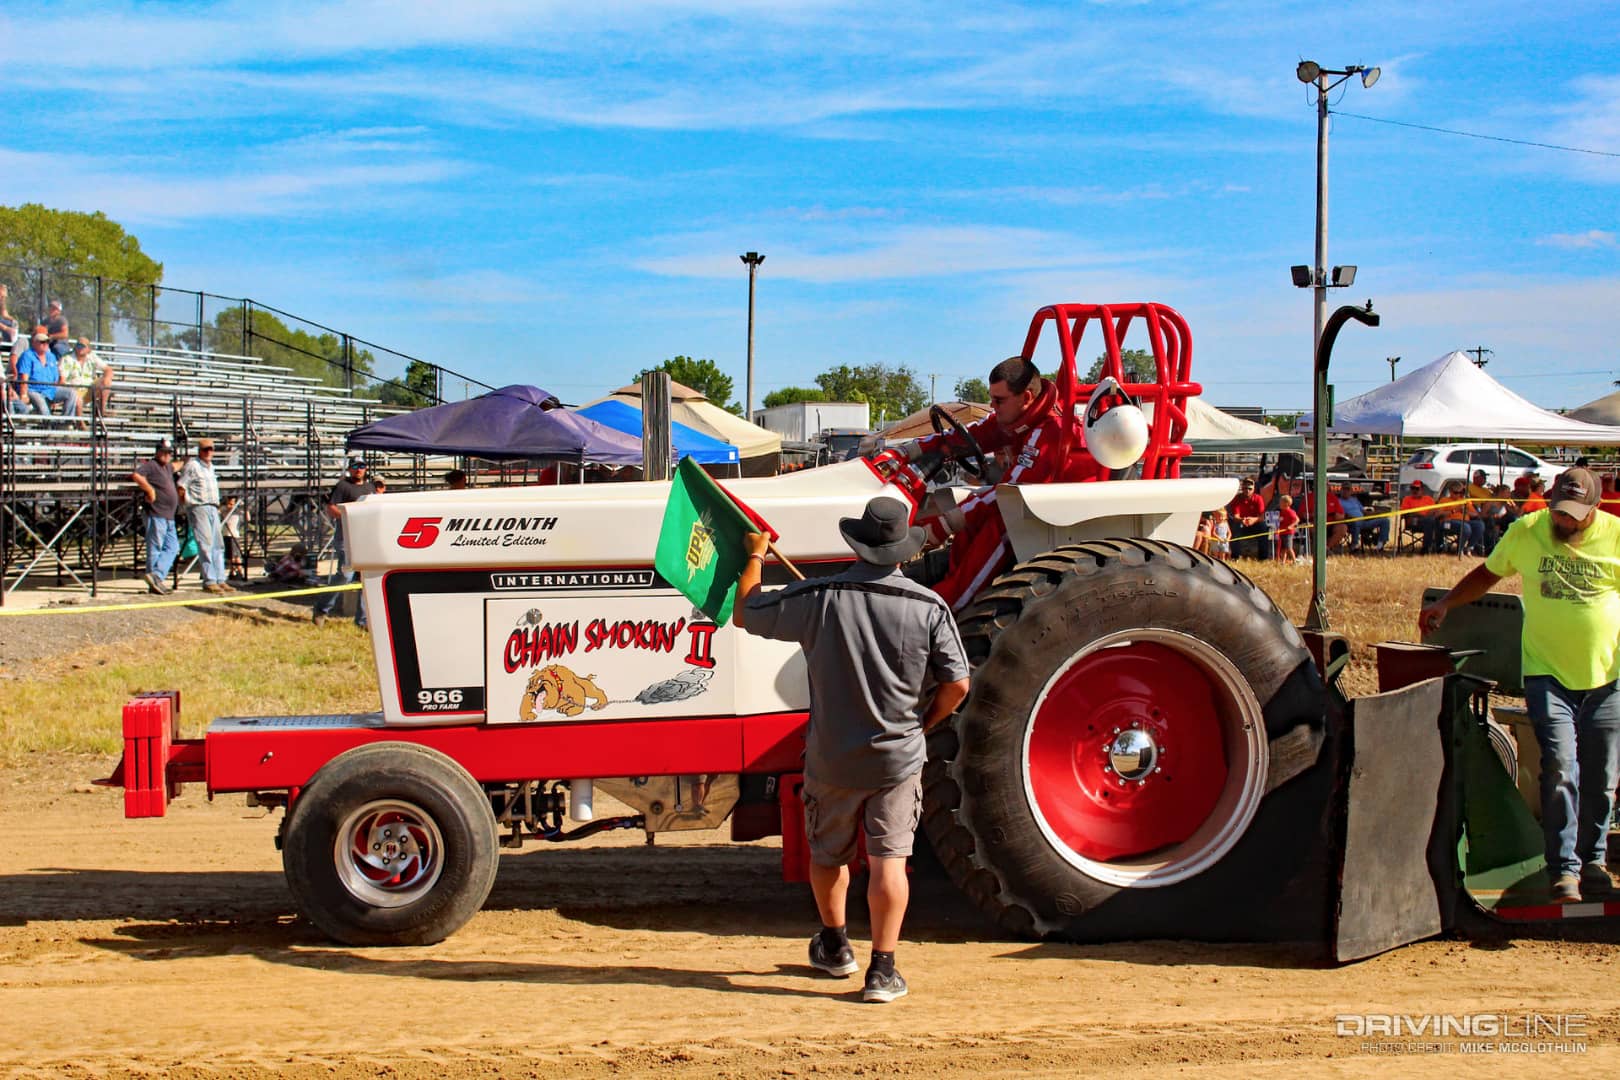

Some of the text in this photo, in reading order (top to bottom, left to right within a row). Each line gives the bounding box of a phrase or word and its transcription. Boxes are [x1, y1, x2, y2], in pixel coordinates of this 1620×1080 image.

[397, 516, 558, 549] 5 MILLIONTH
[451, 533, 547, 547] Limited Edition
[687, 523, 714, 567] UPA
[498, 573, 648, 587] INTERNATIONAL
[503, 619, 578, 673] CHAIN
[684, 620, 718, 668] II
[417, 689, 463, 704] 966
